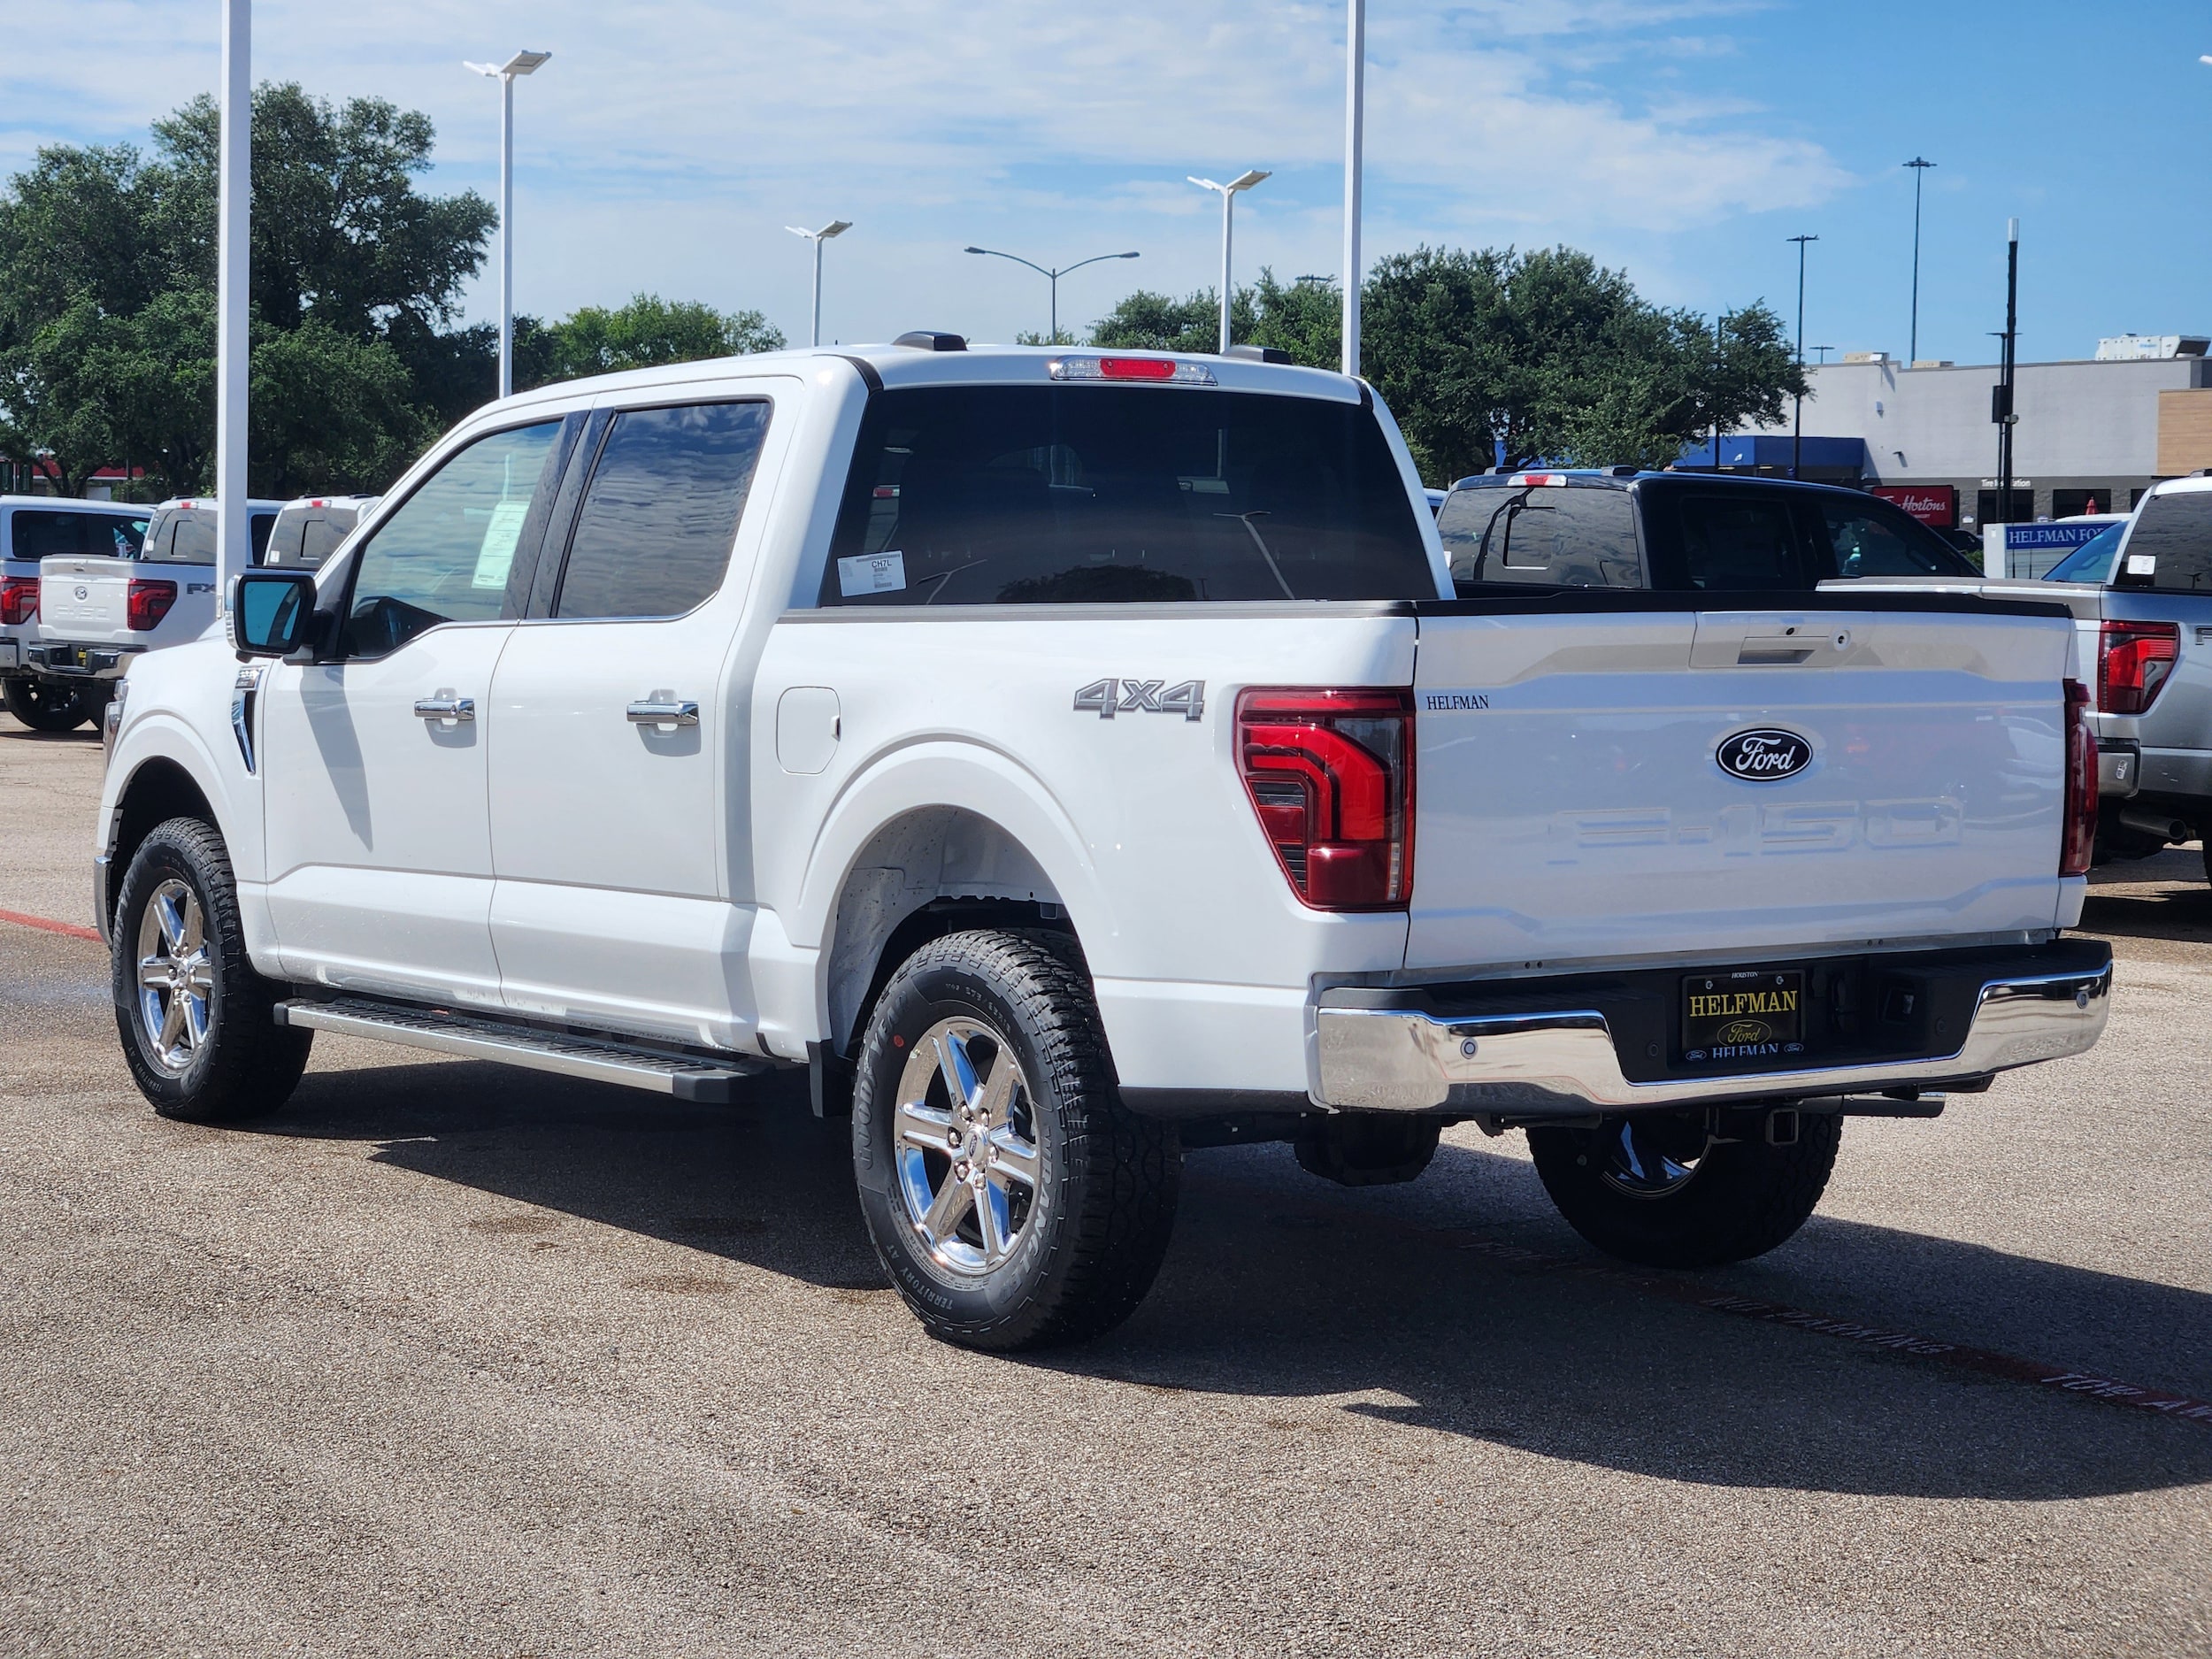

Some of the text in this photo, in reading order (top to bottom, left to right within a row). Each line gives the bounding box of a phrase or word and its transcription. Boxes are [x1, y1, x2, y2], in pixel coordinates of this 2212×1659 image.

[1902, 495, 1946, 511] Hortons
[2008, 529, 2076, 543] HELFMAN
[872, 559, 892, 568] CH7L
[1426, 695, 1489, 710] HELFMAN
[1735, 737, 1796, 771] Ford
[1689, 990, 1798, 1017] HELFMAN
[1727, 1023, 1761, 1043] Ford
[1712, 1043, 1778, 1059] HELFMAN
[858, 989, 908, 1171] GOODYEAR
[1000, 1125, 1053, 1304] WRANGLER
[887, 1243, 900, 1260] AT
[900, 1266, 954, 1310] TERRITORY
